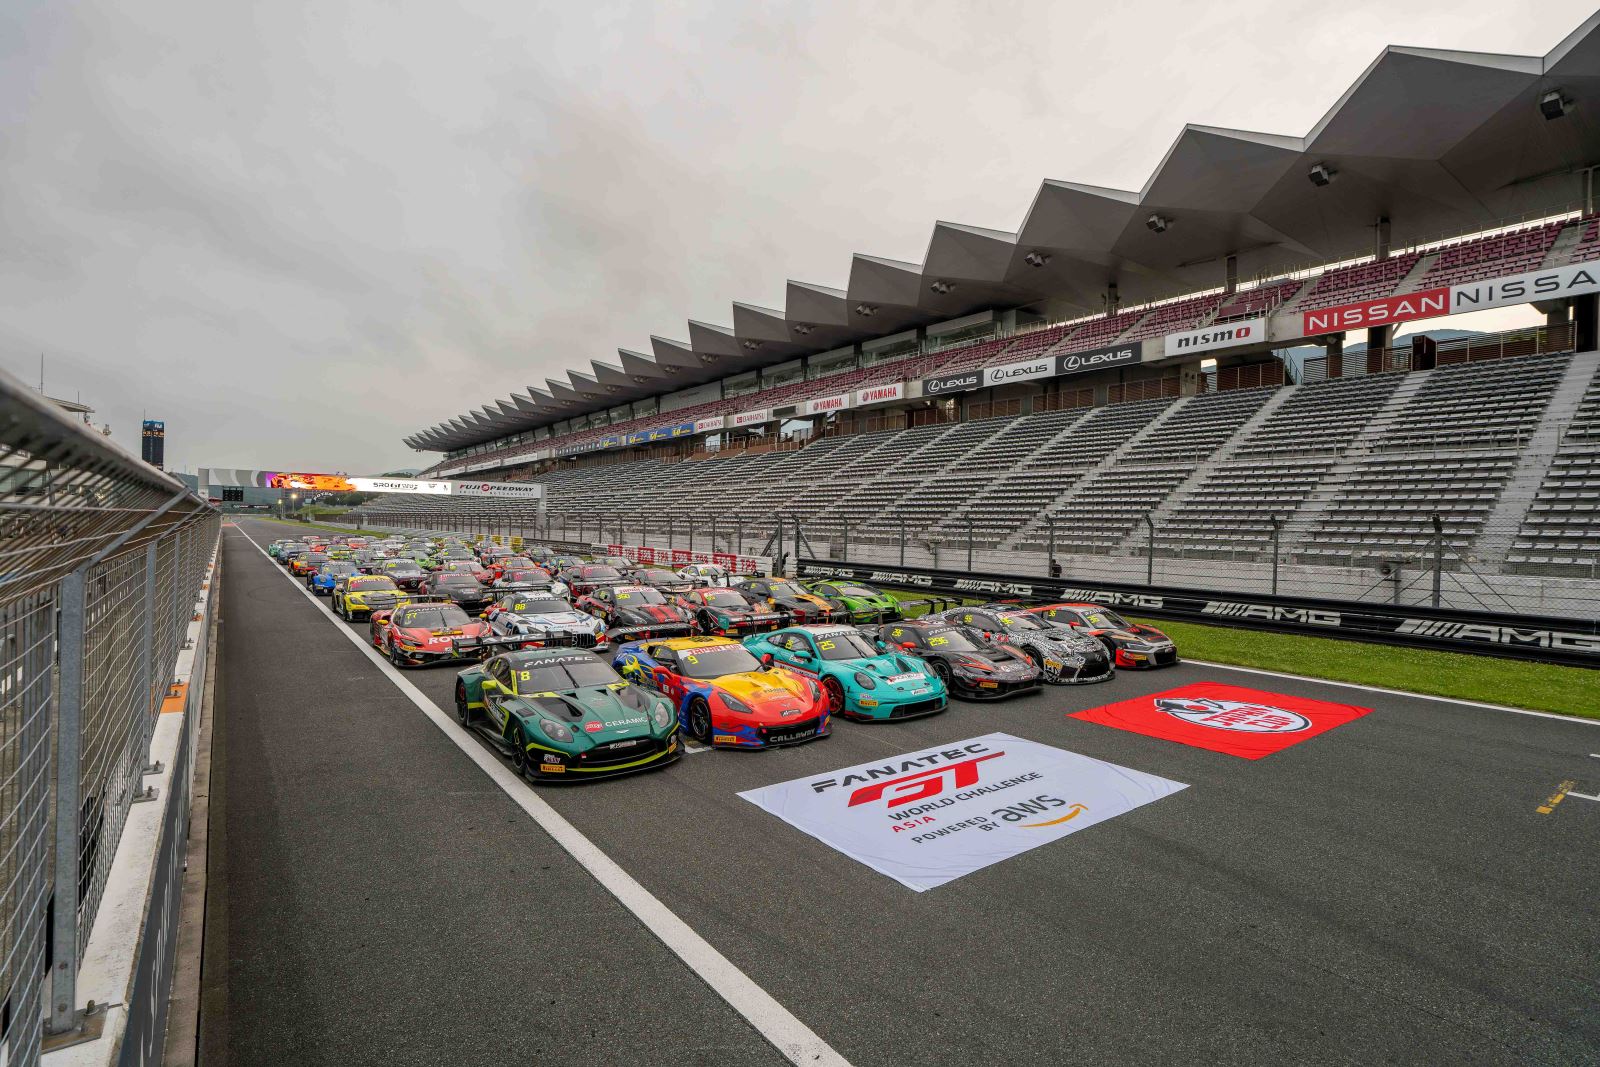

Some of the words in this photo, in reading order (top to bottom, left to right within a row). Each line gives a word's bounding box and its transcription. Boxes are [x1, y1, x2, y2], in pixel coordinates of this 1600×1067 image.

[1309, 294, 1444, 331] NISSAN
[1177, 326, 1251, 348] nismo
[1081, 349, 1133, 364] LEXUS
[1006, 364, 1047, 378] LEXUS
[939, 376, 977, 389] LEXUS
[869, 387, 897, 400] YAMAHA
[818, 398, 843, 411] YAMAHA
[891, 573, 933, 587] AMG
[977, 581, 1032, 596] AMG
[1091, 591, 1164, 609] AMG
[1240, 604, 1341, 627] AMG
[819, 640, 836, 650] 25
[1453, 624, 1600, 654] AMG
[523, 655, 594, 668] FANATEC
[687, 655, 698, 665] 9
[520, 671, 531, 681] 8
[605, 716, 648, 727] CERAMIC
[769, 728, 816, 743] CALLAWAY
[810, 743, 990, 794] FANATEC
[847, 750, 1006, 809] GT
[888, 797, 956, 821] WORLD
[958, 771, 1044, 802] CHALLENGE
[990, 794, 1067, 824] aws
[891, 815, 936, 833] ASIA
[911, 815, 986, 844] POWERED
[980, 821, 999, 833] BY
